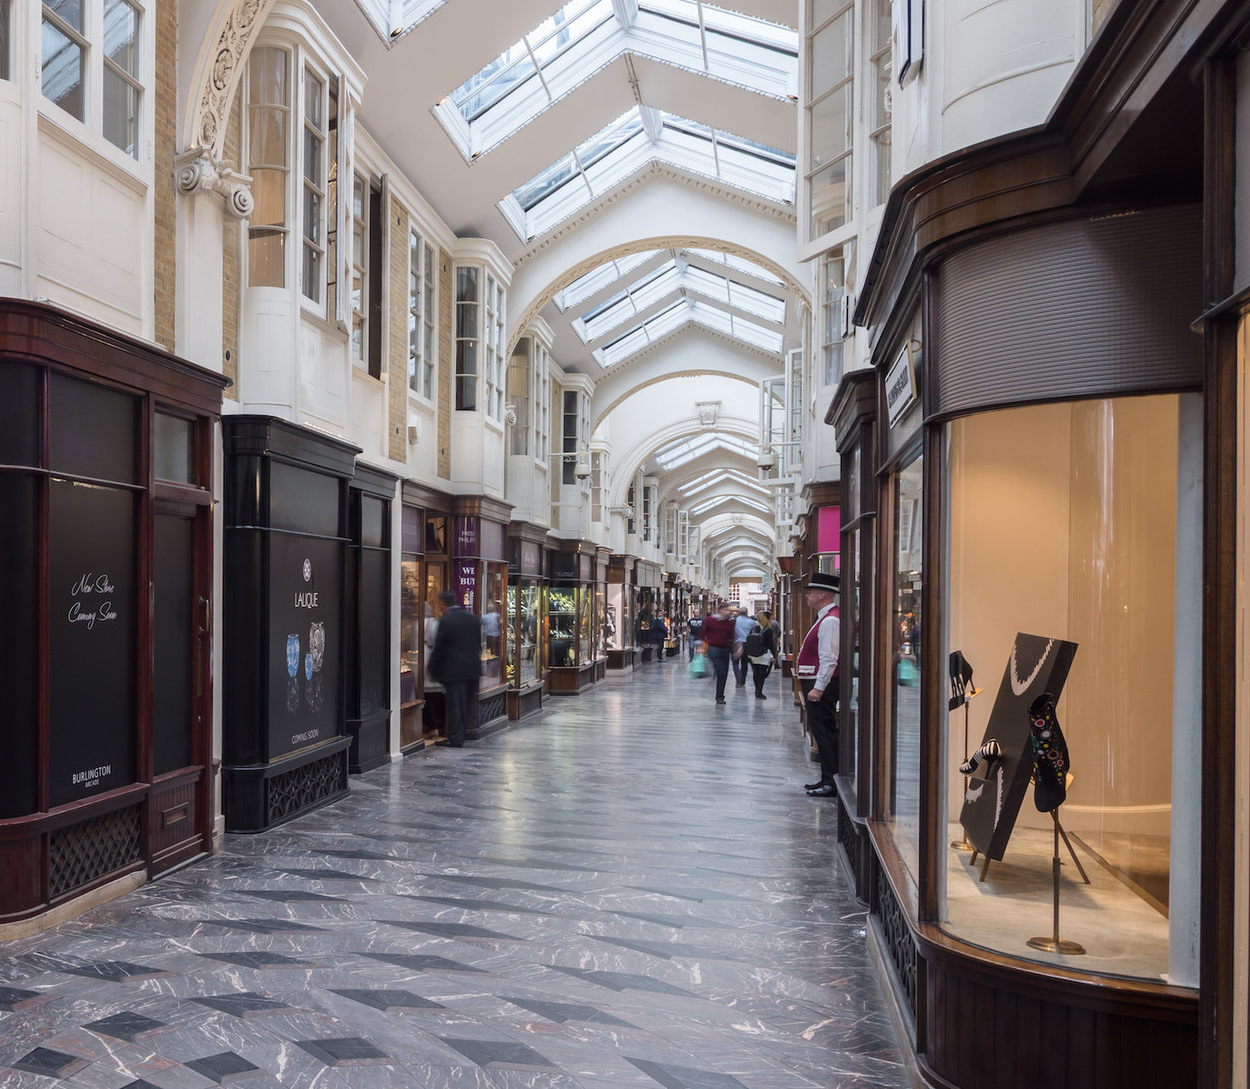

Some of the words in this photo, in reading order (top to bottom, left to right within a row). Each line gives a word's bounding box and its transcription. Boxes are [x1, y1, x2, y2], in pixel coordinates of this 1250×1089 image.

[462, 567, 475, 575] WE
[71, 573, 94, 596] New
[95, 574, 114, 593] Store
[68, 602, 96, 630] Coming
[98, 601, 117, 621] Soon
[72, 764, 111, 784] BURLINGTON
[84, 779, 100, 789] ARCADE
